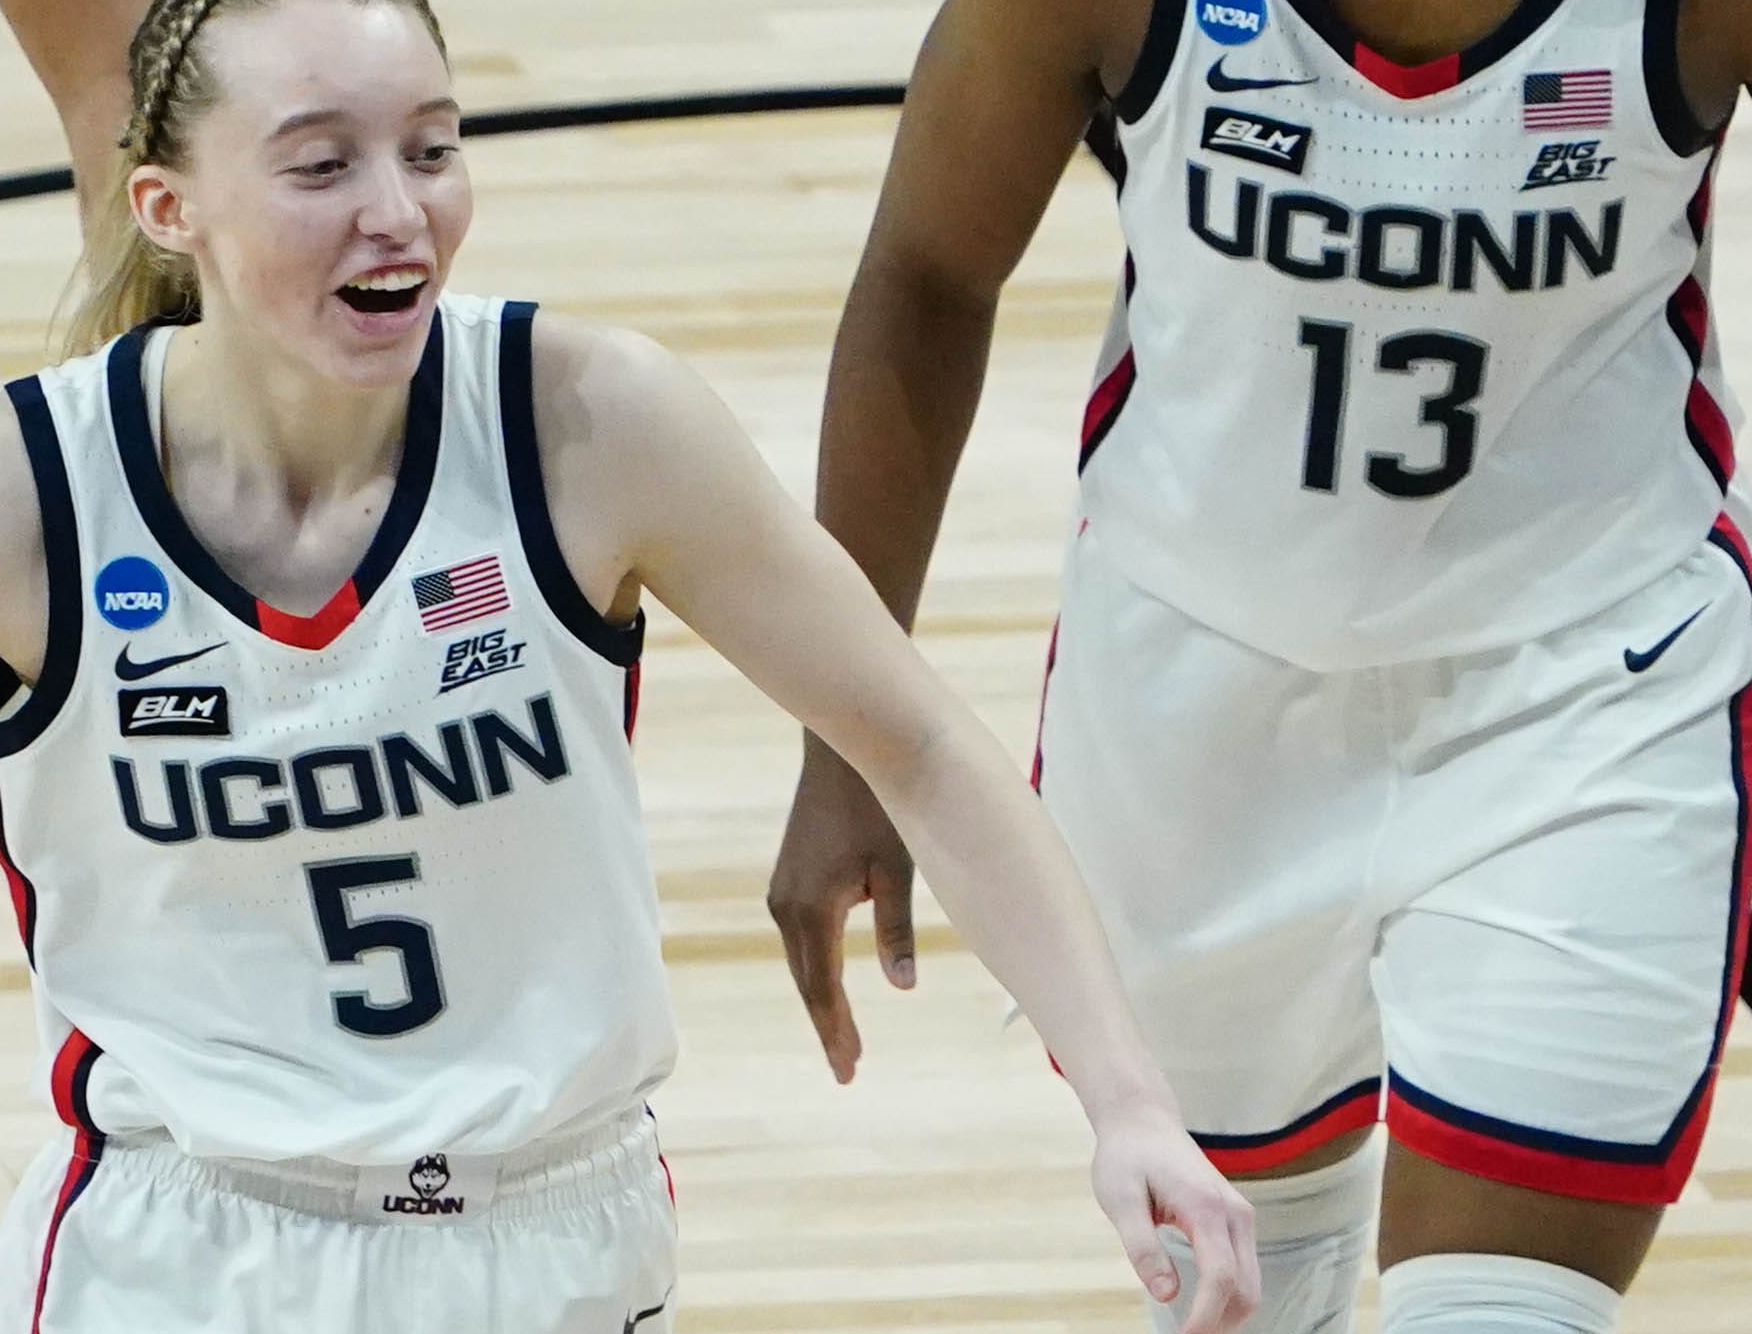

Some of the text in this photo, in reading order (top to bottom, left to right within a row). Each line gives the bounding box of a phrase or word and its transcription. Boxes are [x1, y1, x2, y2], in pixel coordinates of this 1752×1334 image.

[1202, 2, 1260, 32] NCAA
[1214, 118, 1302, 153] BLM
[1537, 139, 1601, 163] BIG
[1526, 156, 1617, 181] EAST
[1185, 158, 1627, 294] UCONN
[1297, 315, 1492, 501] 13
[103, 591, 163, 611] NCAA
[441, 642, 527, 683] EAST
[445, 629, 506, 663] BIG
[131, 695, 218, 719] BLM
[108, 691, 572, 846] UCONN
[302, 851, 448, 1041] 5
[382, 1195, 465, 1215] UCONN
